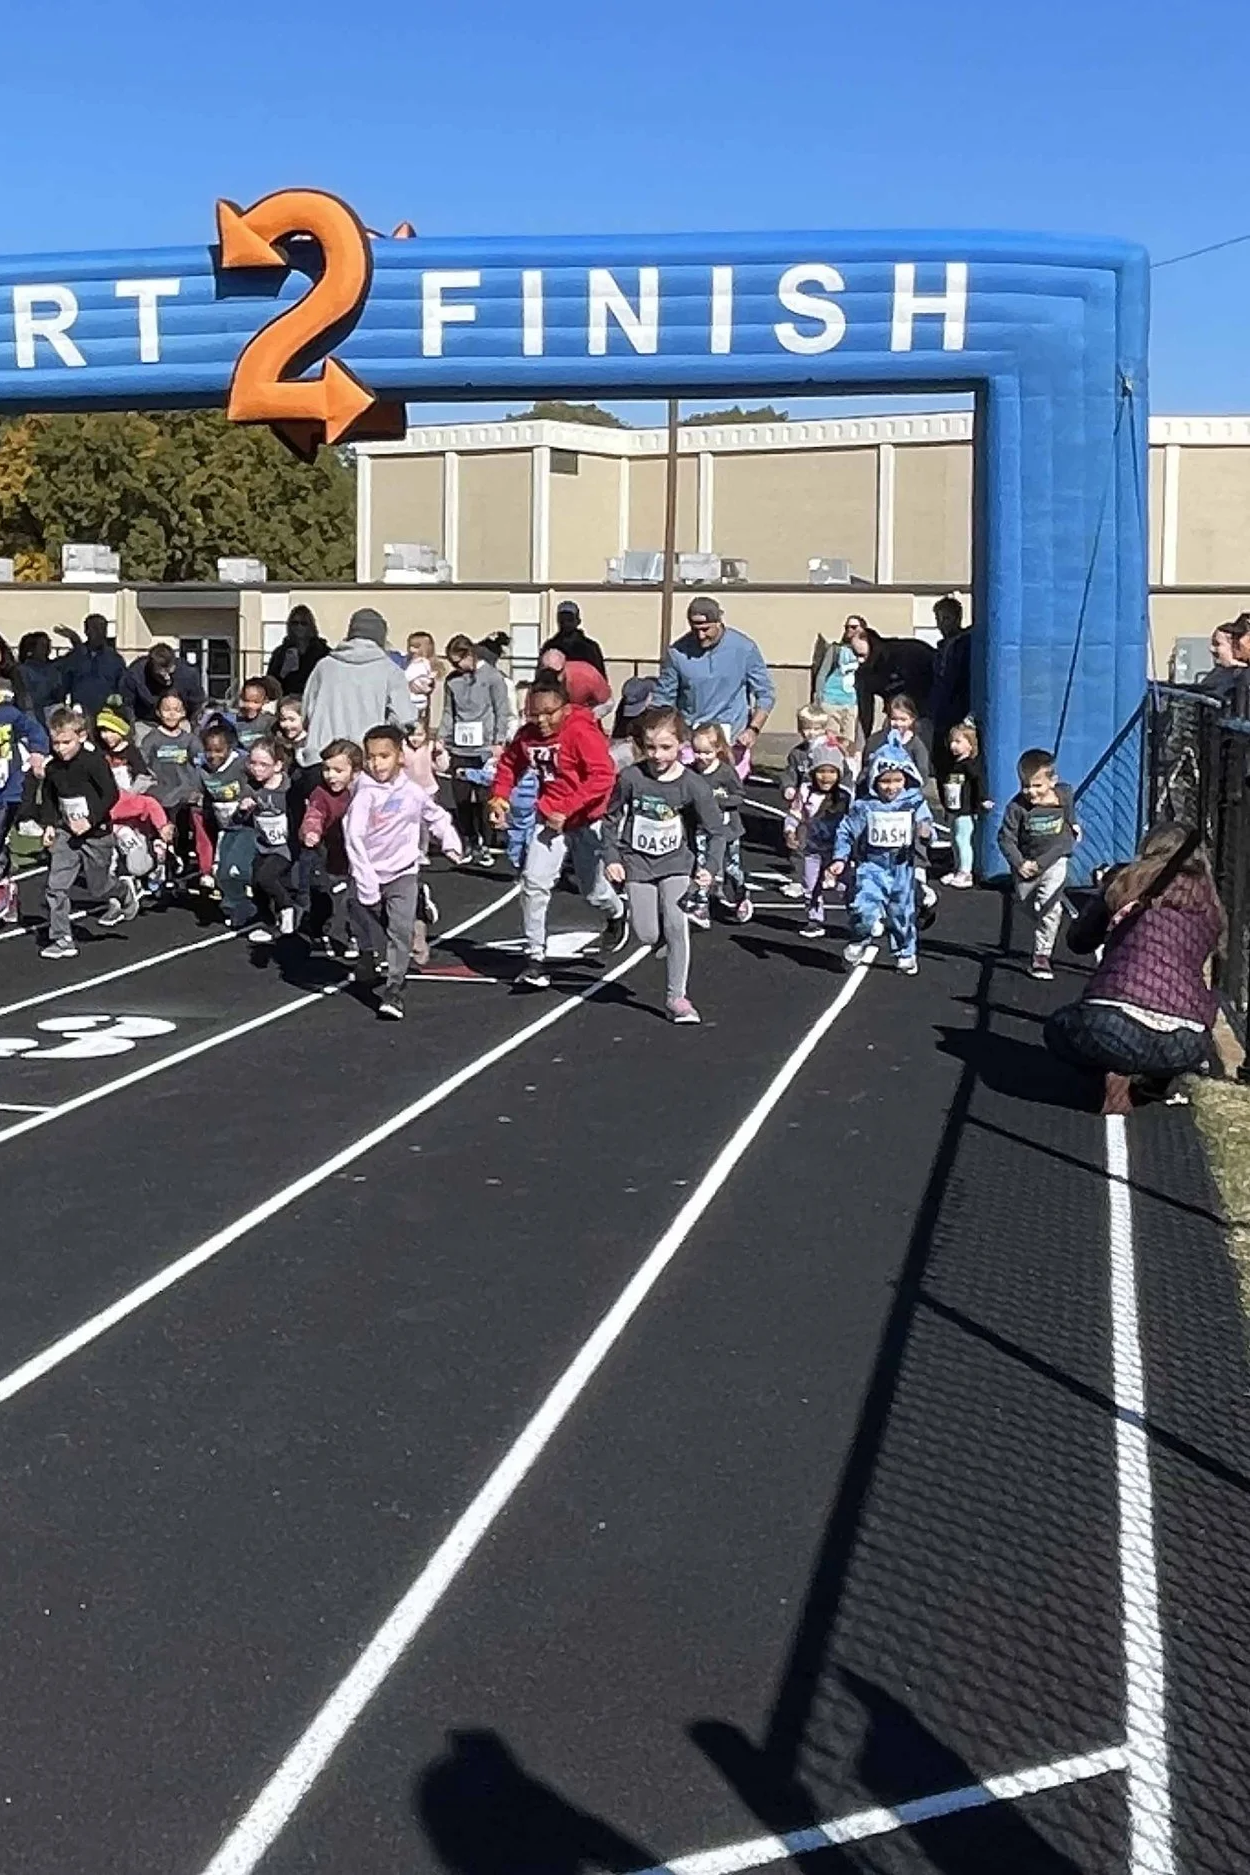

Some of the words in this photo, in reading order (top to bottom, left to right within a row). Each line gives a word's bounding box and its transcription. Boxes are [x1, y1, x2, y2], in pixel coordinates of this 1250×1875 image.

[215, 188, 377, 447] 2
[421, 261, 969, 357] FINISH
[637, 834, 679, 852] DASH
[871, 827, 907, 843] DASH
